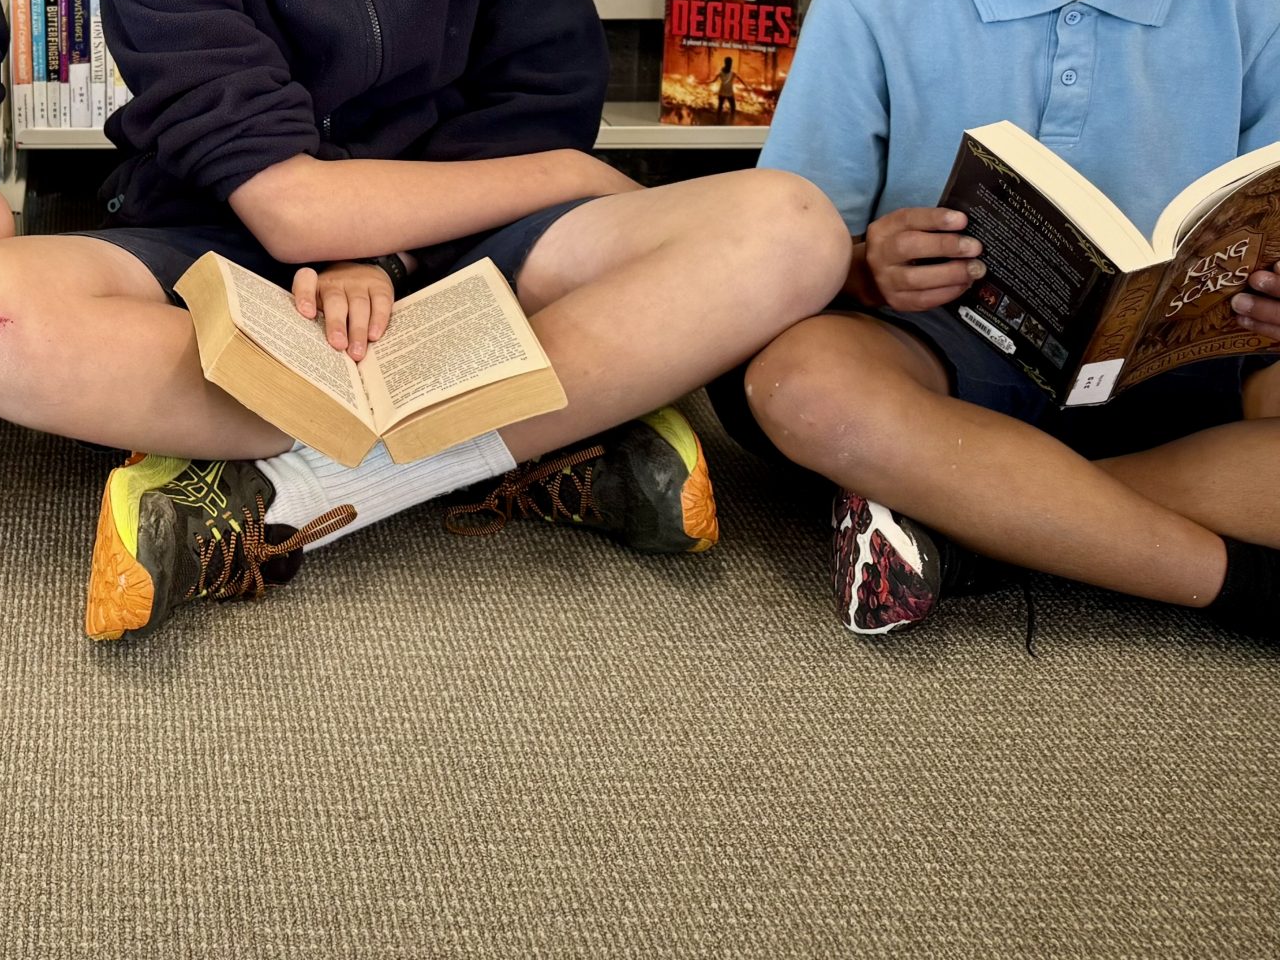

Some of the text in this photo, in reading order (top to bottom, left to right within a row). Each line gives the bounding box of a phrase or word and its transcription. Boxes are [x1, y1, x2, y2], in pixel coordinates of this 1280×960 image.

[46, 6, 59, 71] BUTTERFINGERS
[672, 0, 792, 44] DEGREES
[1183, 238, 1250, 288] KING
[1165, 265, 1250, 317] SCARS
